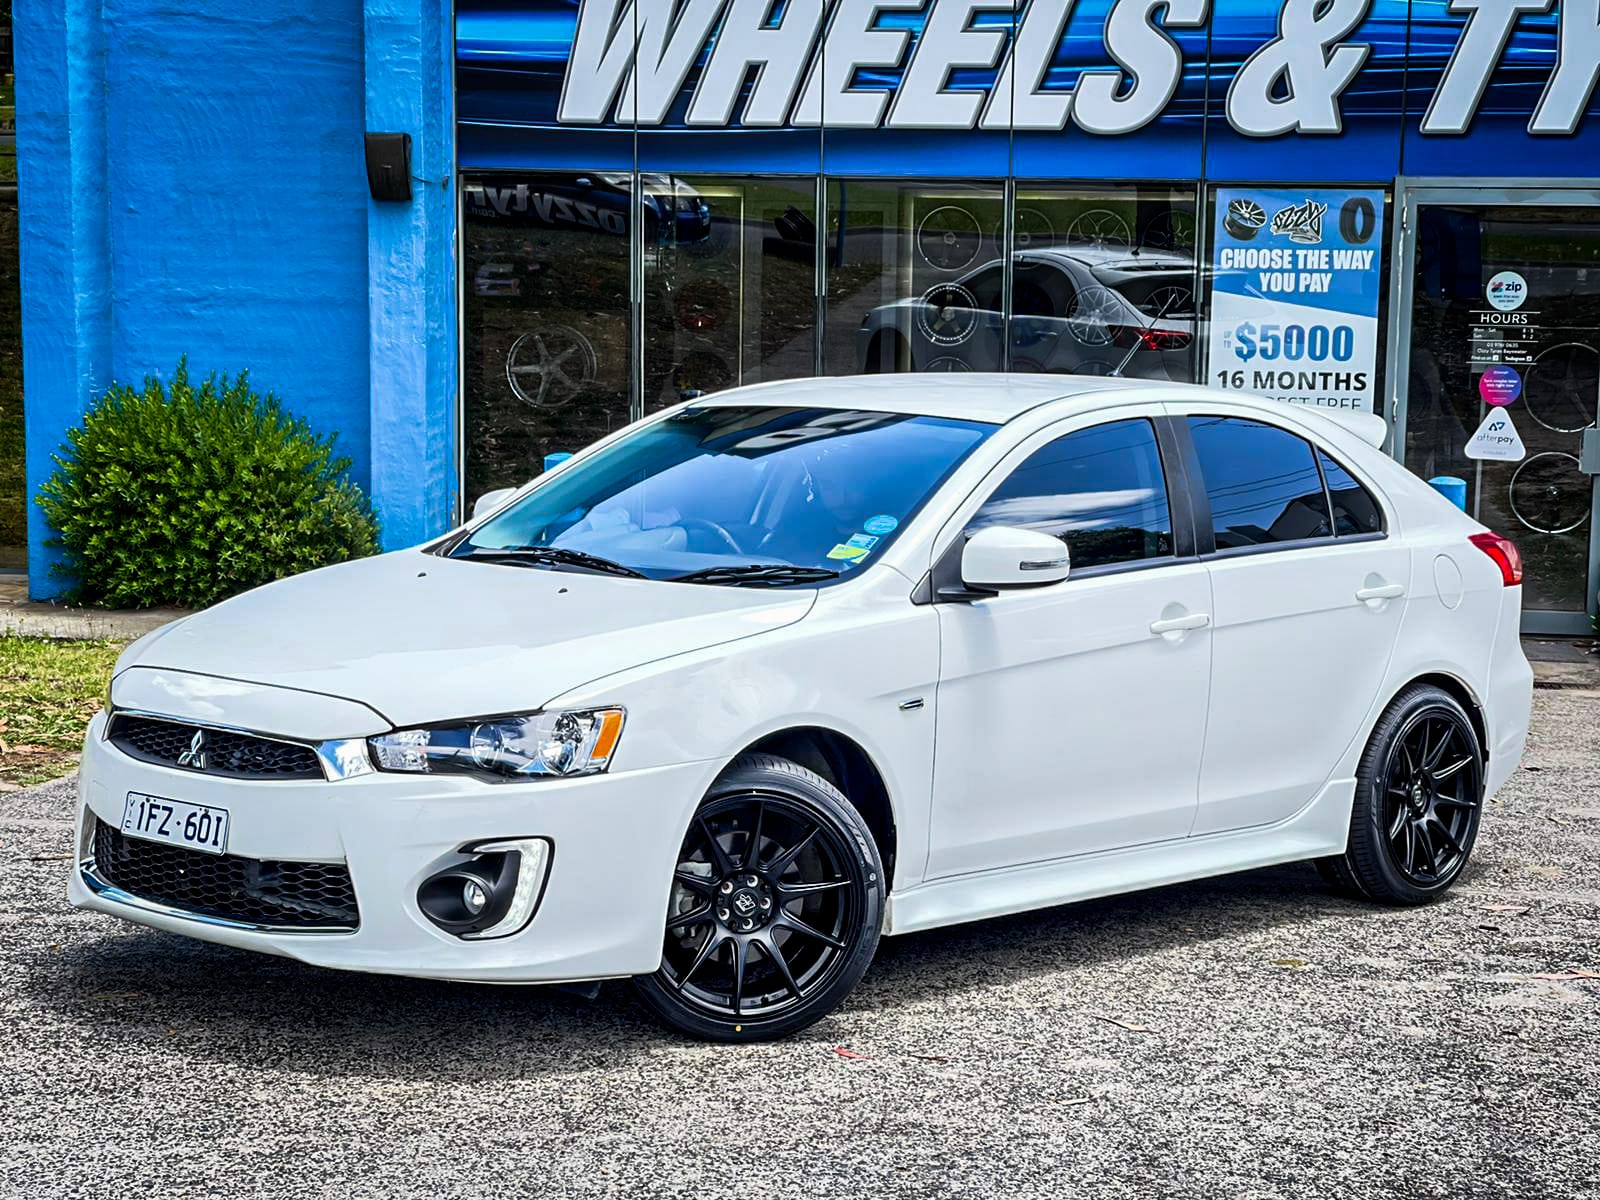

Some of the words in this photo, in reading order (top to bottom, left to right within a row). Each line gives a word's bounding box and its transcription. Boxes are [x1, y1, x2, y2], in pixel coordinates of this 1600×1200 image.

[556, 0, 1209, 135] WHEELS
[1226, 0, 1370, 136] &
[1220, 248, 1293, 270] CHOOSE
[1296, 250, 1330, 270] THE
[1332, 250, 1374, 270] WAY
[1259, 272, 1295, 293] YOU
[1299, 273, 1332, 294] PAY
[1505, 281, 1523, 293] zip
[1480, 313, 1528, 324] HOURS
[1235, 321, 1354, 363] $5000
[1217, 370, 1246, 390] 16
[1253, 370, 1368, 392] MONTHS
[1476, 433, 1515, 446] afterpay
